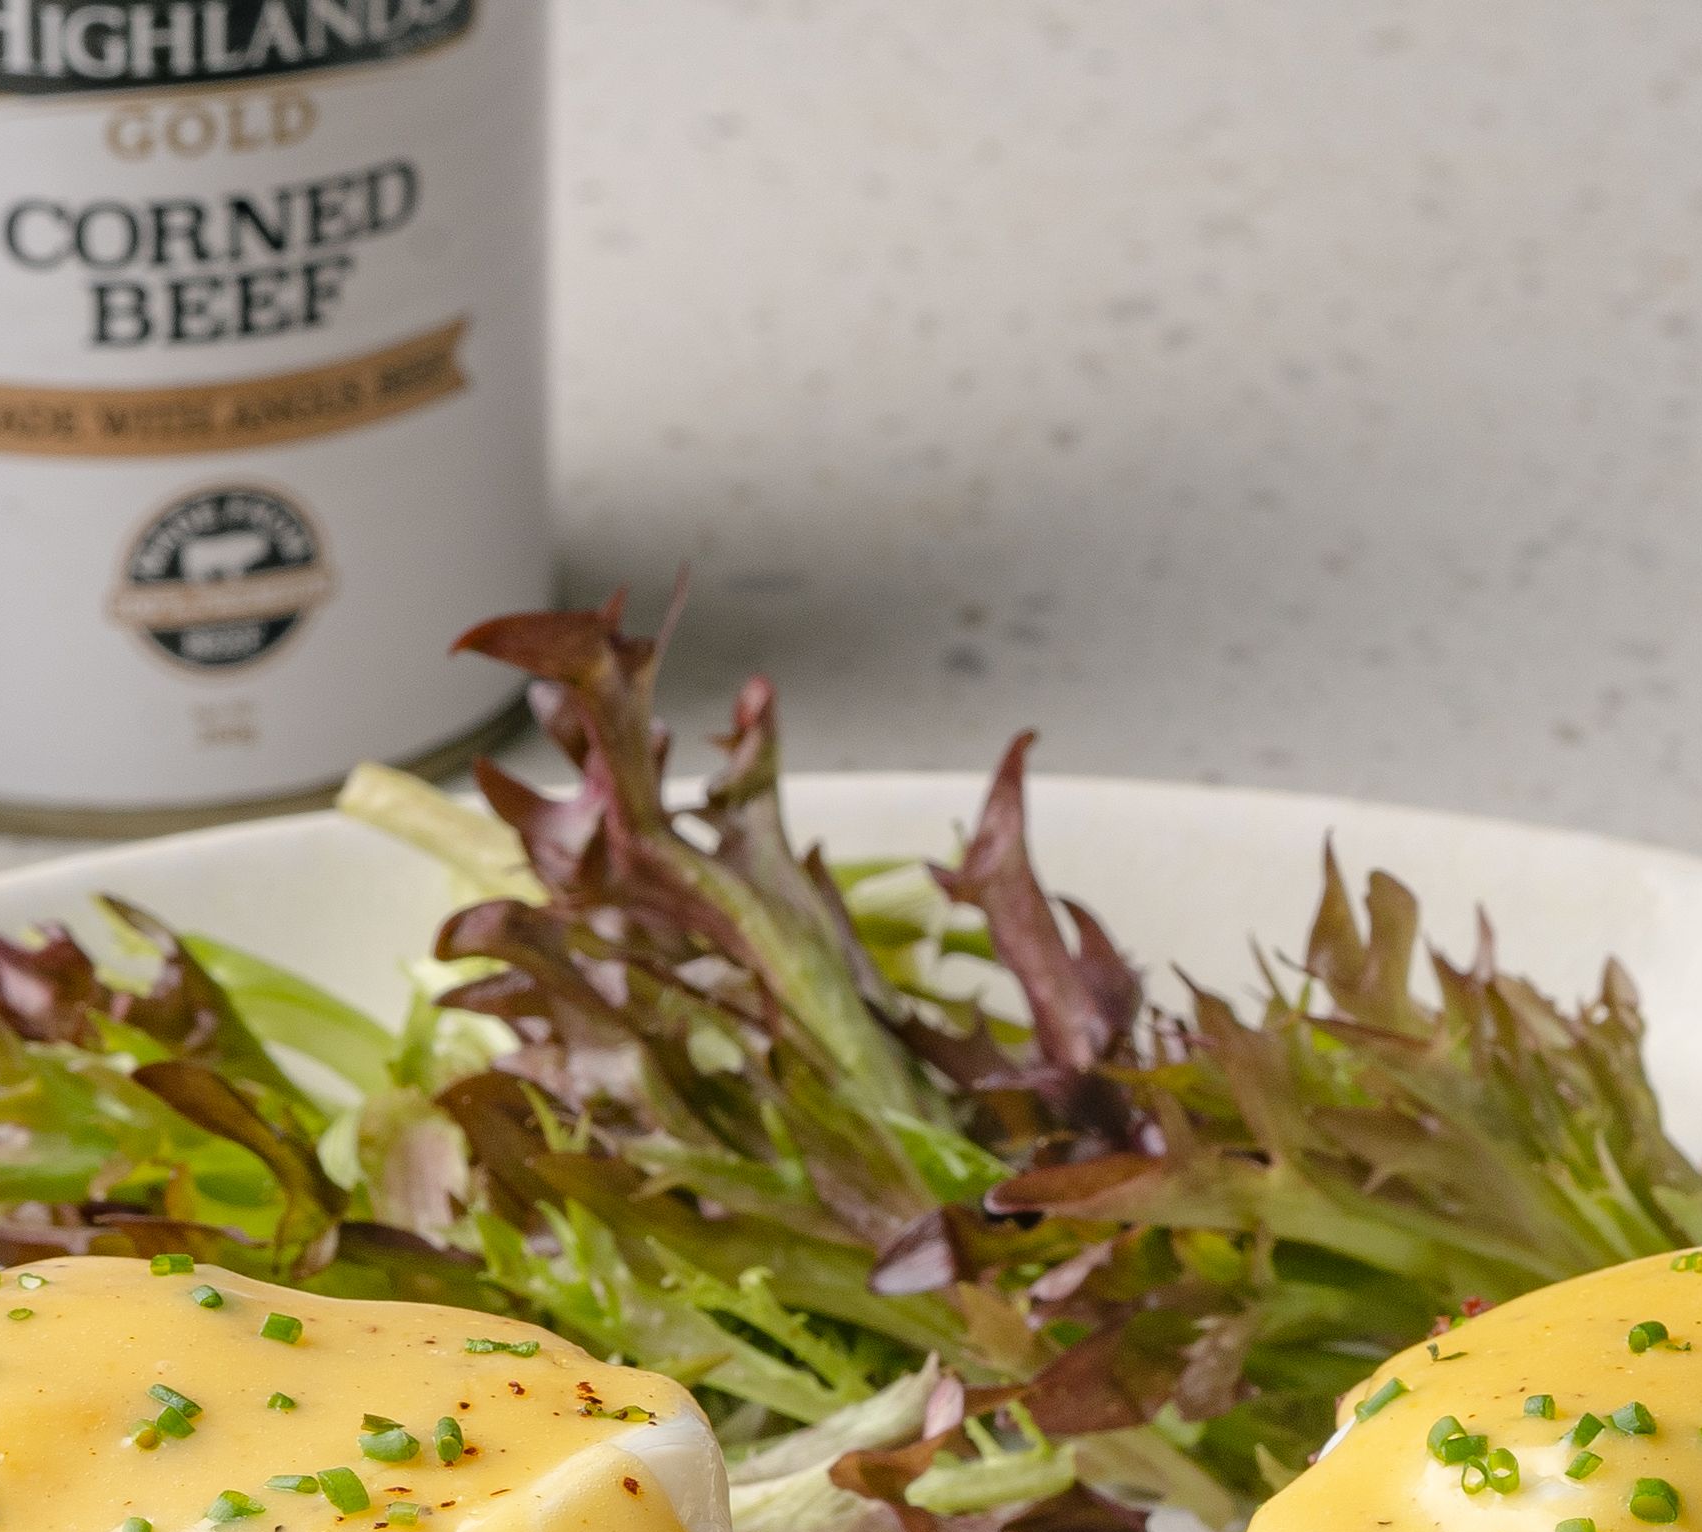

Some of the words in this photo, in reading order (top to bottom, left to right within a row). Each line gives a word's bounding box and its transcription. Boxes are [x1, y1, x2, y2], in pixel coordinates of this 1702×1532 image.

[103, 88, 317, 162] GOLD
[2, 157, 422, 271] CORNED
[89, 254, 354, 349] BEEF
